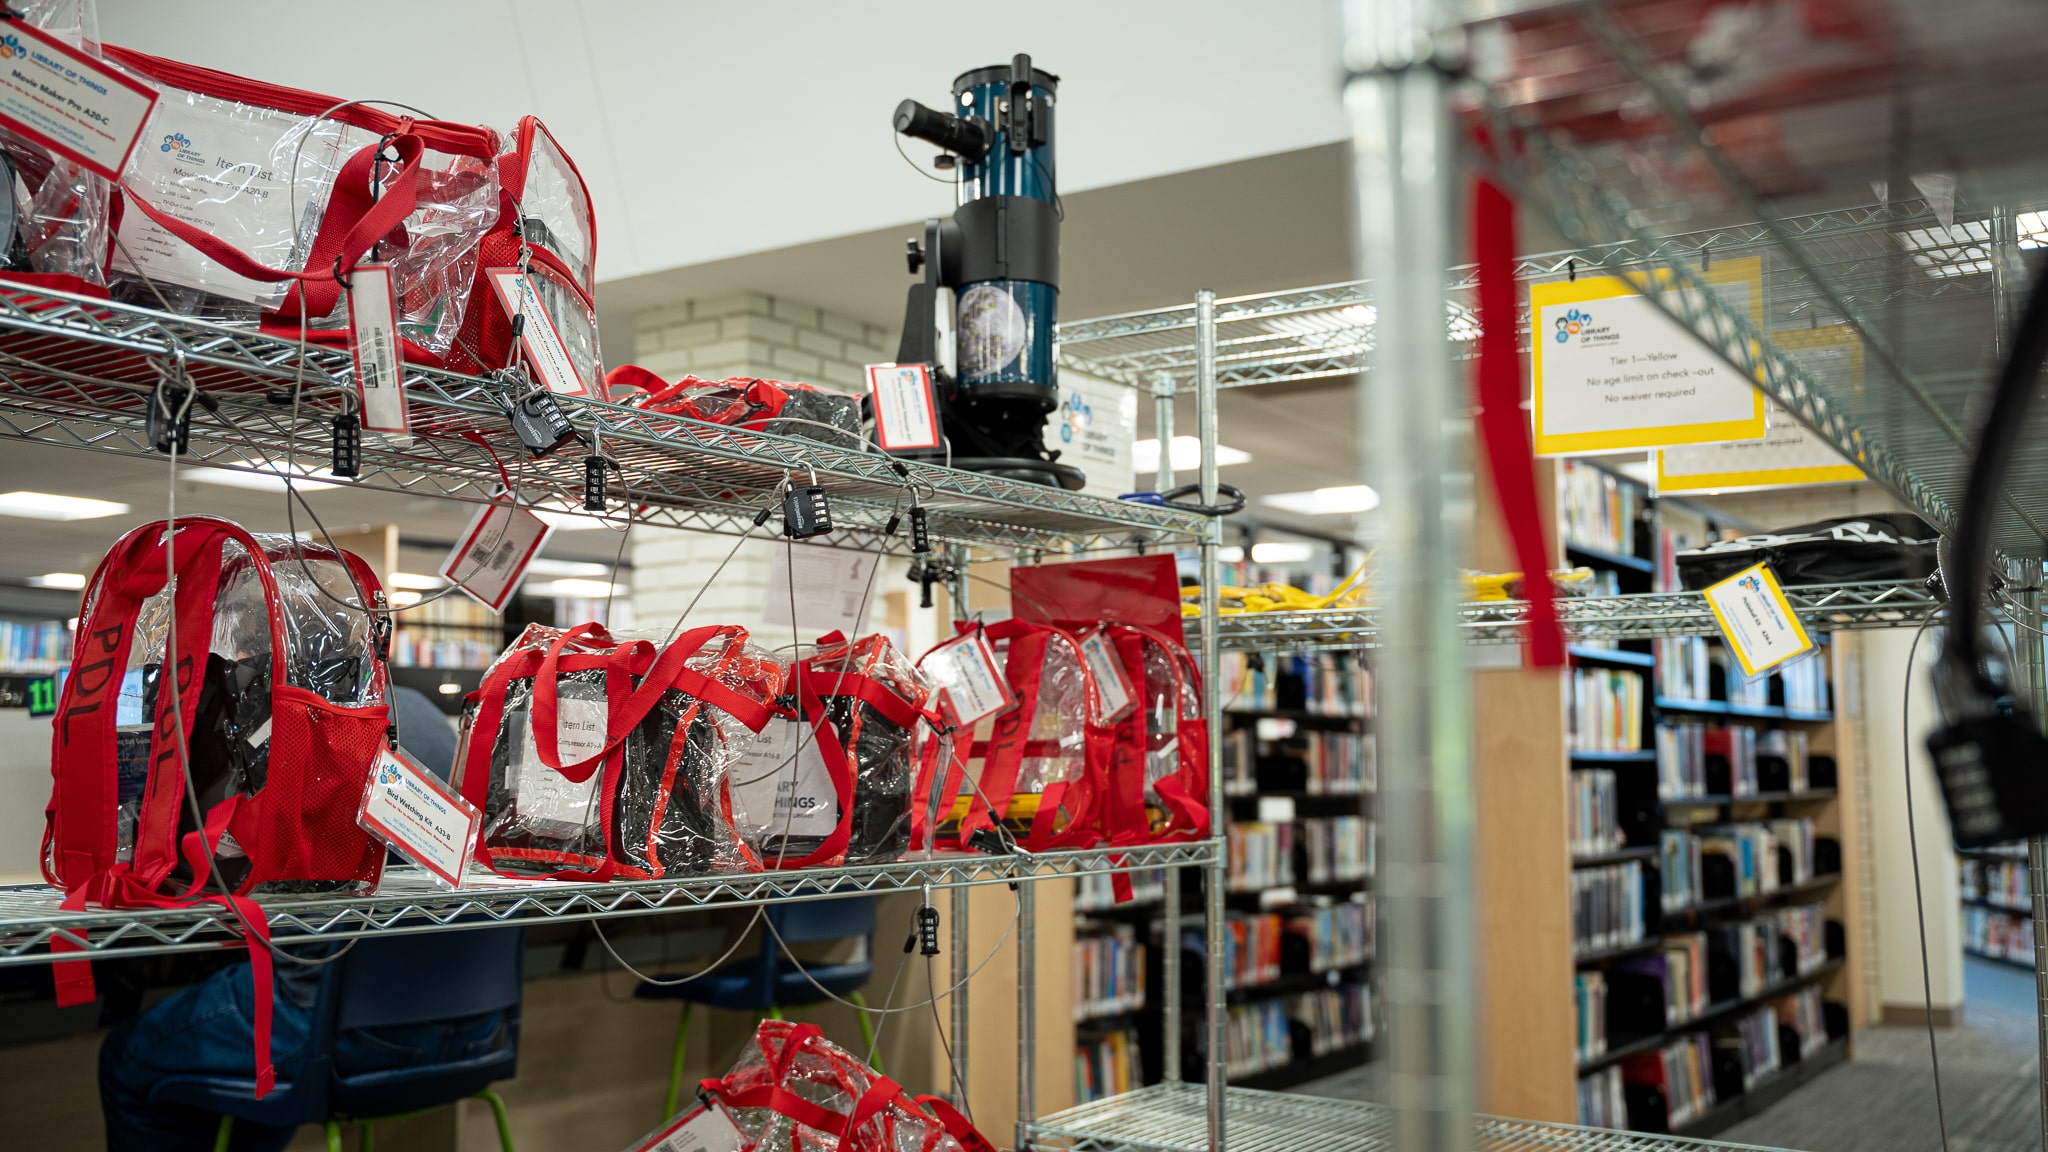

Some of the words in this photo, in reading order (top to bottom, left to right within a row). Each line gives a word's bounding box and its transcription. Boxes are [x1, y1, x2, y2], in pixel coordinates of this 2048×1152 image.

[31, 51, 63, 71] LIBRARY
[65, 69, 76, 78] OF
[78, 76, 107, 95] THINGS
[11, 70, 37, 87] Movie
[39, 84, 65, 102] Maker
[68, 99, 82, 110] Pro
[83, 107, 109, 125] A20-C
[186, 155, 205, 163] THINGS
[216, 157, 246, 172] Item
[250, 166, 273, 180] List
[1581, 327, 1610, 336] LIBRARY
[1593, 333, 1620, 342] THINGS
[1610, 356, 1627, 365] Tier
[1587, 377, 1600, 386] No
[1604, 376, 1621, 387] age
[1623, 373, 1644, 382] limit
[1647, 373, 1659, 381] on
[1661, 368, 1688, 380] check
[1605, 394, 1619, 403] No
[1622, 390, 1651, 402] waiver
[1655, 387, 1696, 400] required
[1766, 437, 1804, 448] required
[64, 621, 123, 748] PDL
[28, 679, 55, 714] 11
[582, 720, 595, 731] List
[757, 734, 772, 744] List
[404, 778, 422, 794] LIBRARY
[430, 798, 447, 813] THINGS
[386, 788, 398, 799] Bird
[397, 798, 424, 820] Watching
[423, 817, 433, 826] Kit
